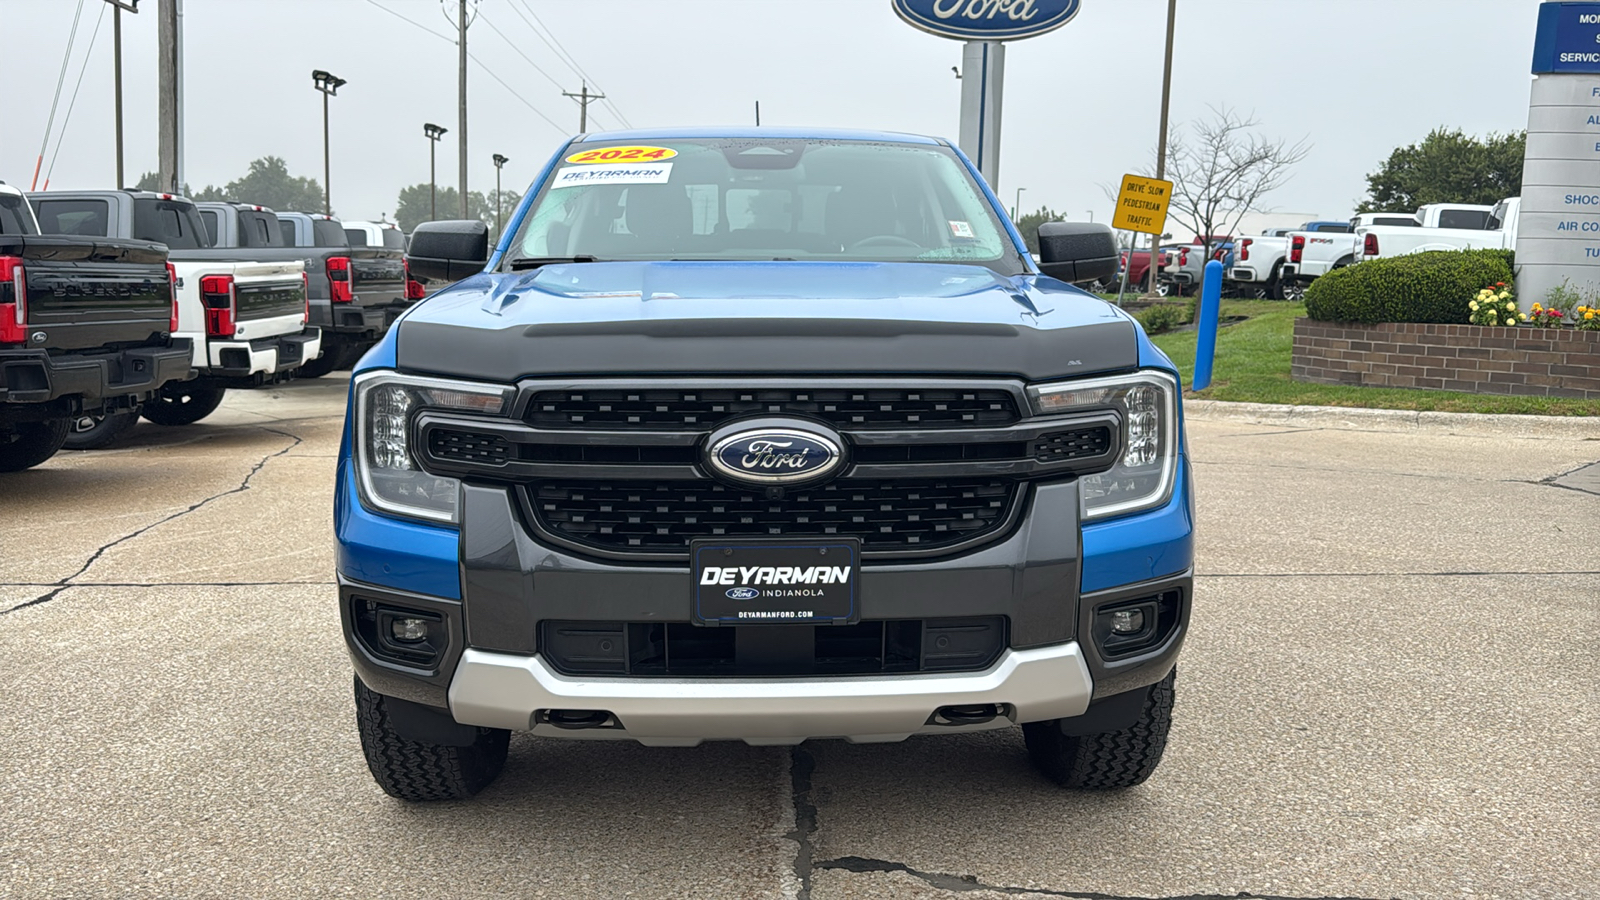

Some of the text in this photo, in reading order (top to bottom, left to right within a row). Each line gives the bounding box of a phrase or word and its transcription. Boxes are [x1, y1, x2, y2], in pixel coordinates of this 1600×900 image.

[1560, 52, 1600, 63] SERVIC
[1592, 87, 1600, 97] F
[575, 149, 668, 162] 2024
[563, 169, 664, 180] DEYARMAN
[1127, 182, 1165, 196] DRIVE SLOW
[1123, 197, 1161, 212] PEDESTRIAN
[1565, 194, 1600, 205] SHOC
[1127, 214, 1152, 226] TRAFFIC
[1557, 221, 1600, 232] AIR CO
[741, 440, 809, 469] Ford
[700, 566, 851, 586] DEYARMAN
[732, 588, 824, 598] Ford INDIANOLA
[738, 610, 813, 619] DEYARMANFORD.COM
